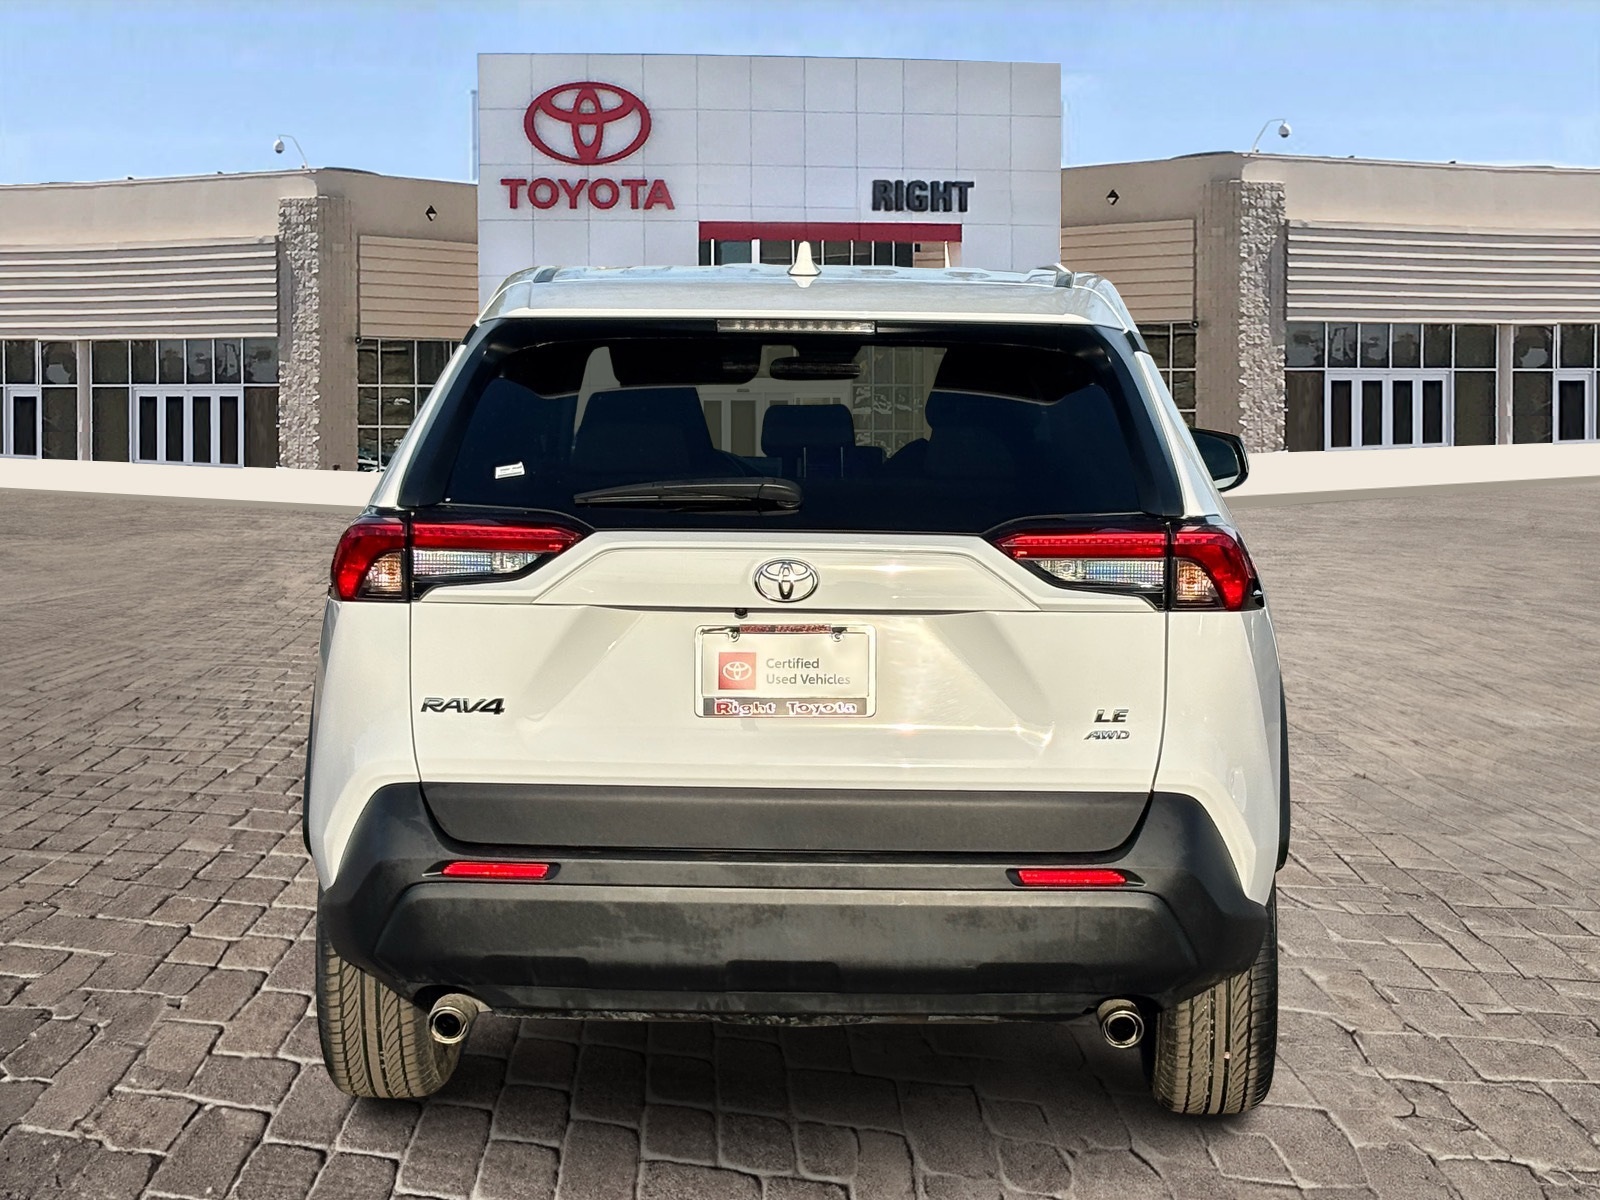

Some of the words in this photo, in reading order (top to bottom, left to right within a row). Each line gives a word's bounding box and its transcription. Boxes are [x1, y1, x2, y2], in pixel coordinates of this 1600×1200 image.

[500, 178, 675, 210] TOYOTA
[871, 179, 975, 213] RIGHT
[766, 657, 820, 670] Certified
[766, 673, 797, 685] Used
[800, 673, 851, 685] Vehicles
[420, 697, 505, 715] RAV4
[714, 699, 776, 716] Right
[786, 700, 858, 716] Toyota
[1093, 708, 1130, 723] LE
[1083, 730, 1131, 741] AWD
